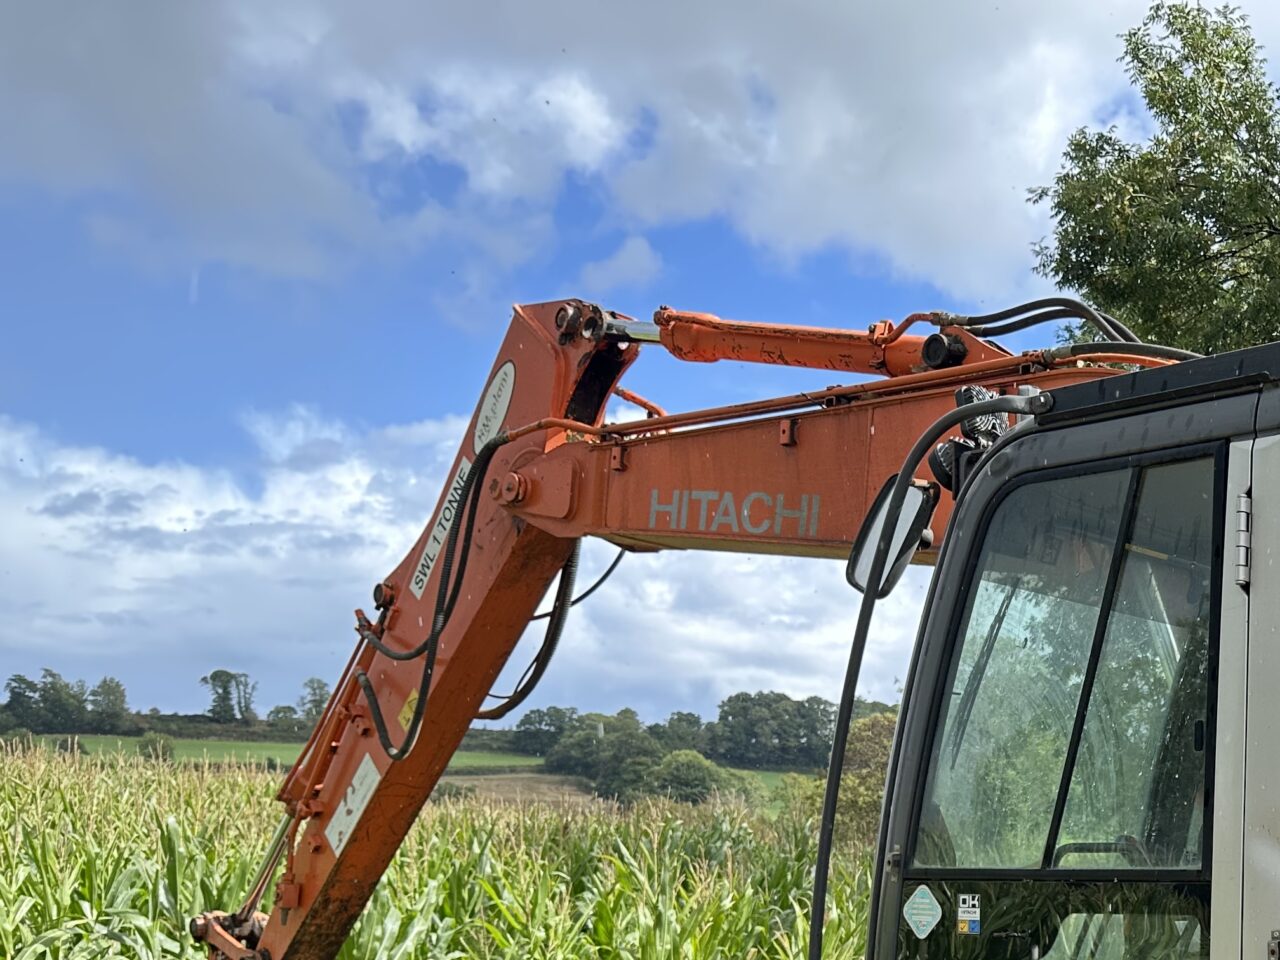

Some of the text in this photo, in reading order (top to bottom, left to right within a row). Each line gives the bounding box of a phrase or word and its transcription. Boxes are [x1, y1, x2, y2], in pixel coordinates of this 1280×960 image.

[414, 466, 468, 590] SWL 1 TONNE
[649, 488, 820, 537] HITACHI
[959, 894, 979, 908] OK
